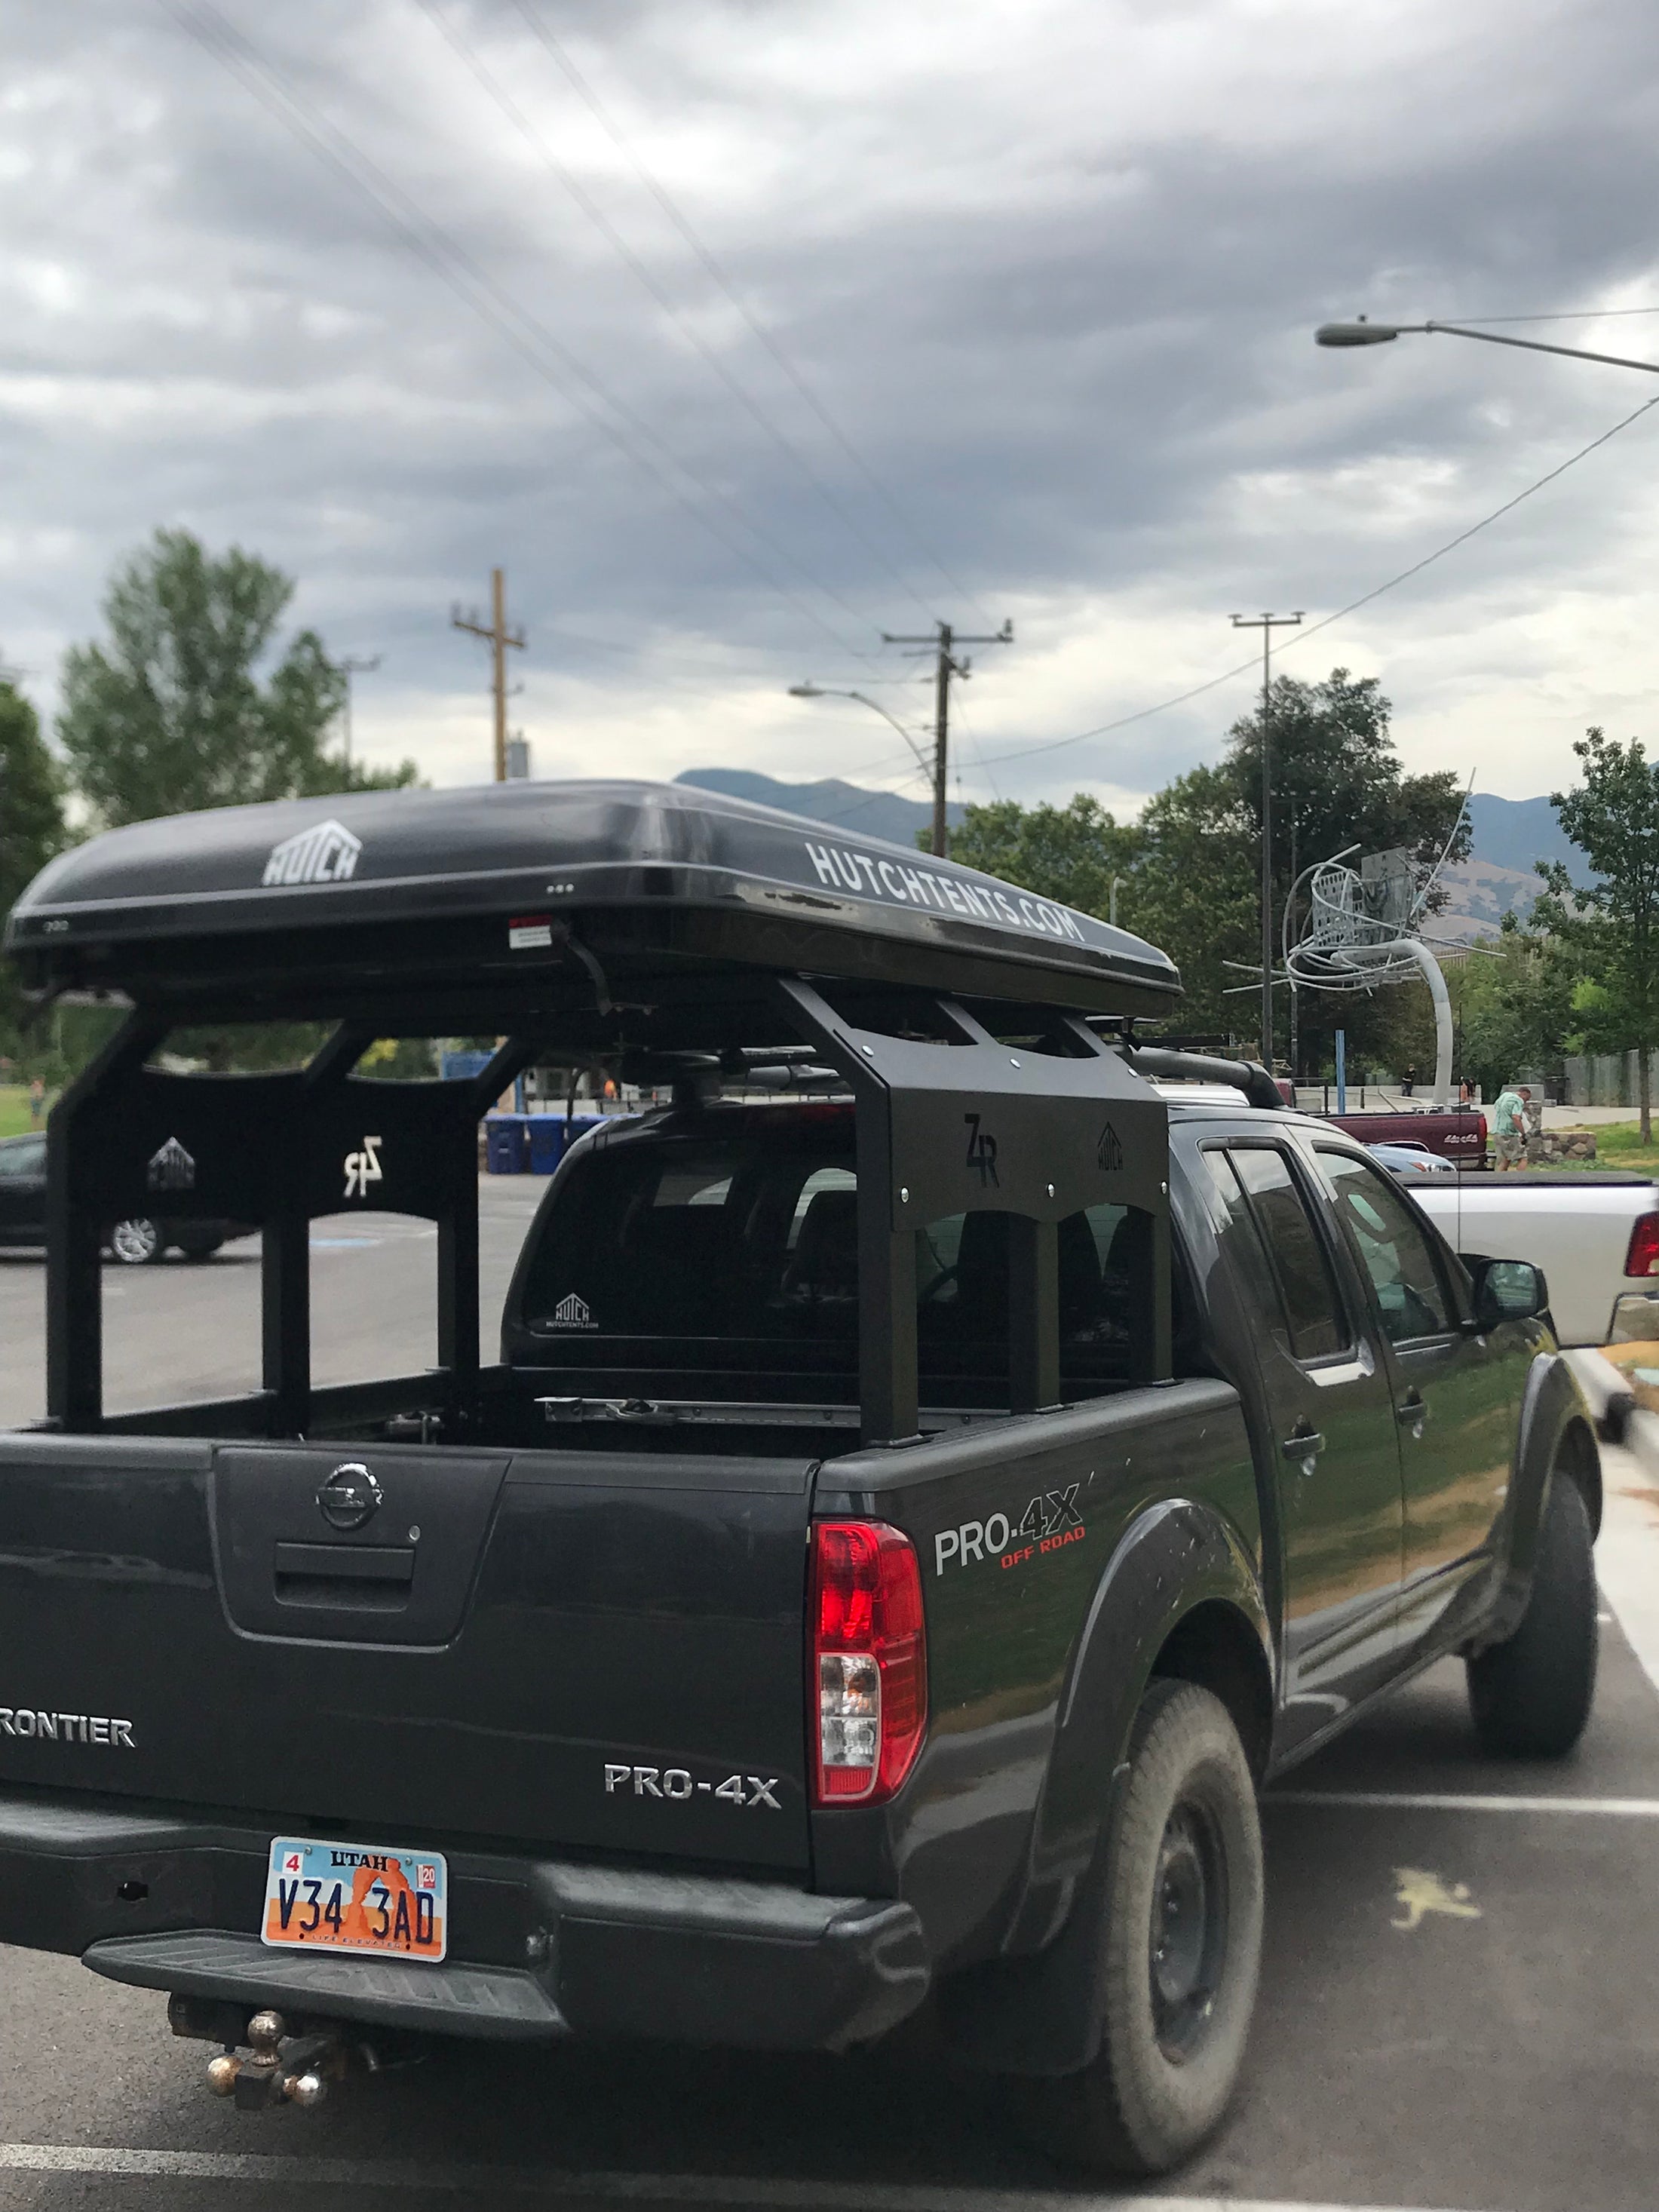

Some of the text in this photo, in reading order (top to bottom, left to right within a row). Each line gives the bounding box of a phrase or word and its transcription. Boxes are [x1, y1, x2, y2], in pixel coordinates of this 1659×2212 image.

[262, 818, 363, 886] HUTCH
[804, 842, 1086, 942] HUTCHTENTS.COM
[556, 1292, 590, 1321] HUTCH
[1001, 1526, 1086, 1569] OFF ROAD
[604, 1763, 782, 1809] PRO-4X
[286, 1854, 300, 1872] 4
[330, 1850, 389, 1873] UTAH
[423, 1867, 435, 1882] 20
[278, 1878, 343, 1934] V34
[311, 1934, 400, 1949] LIFE ELEVATED
